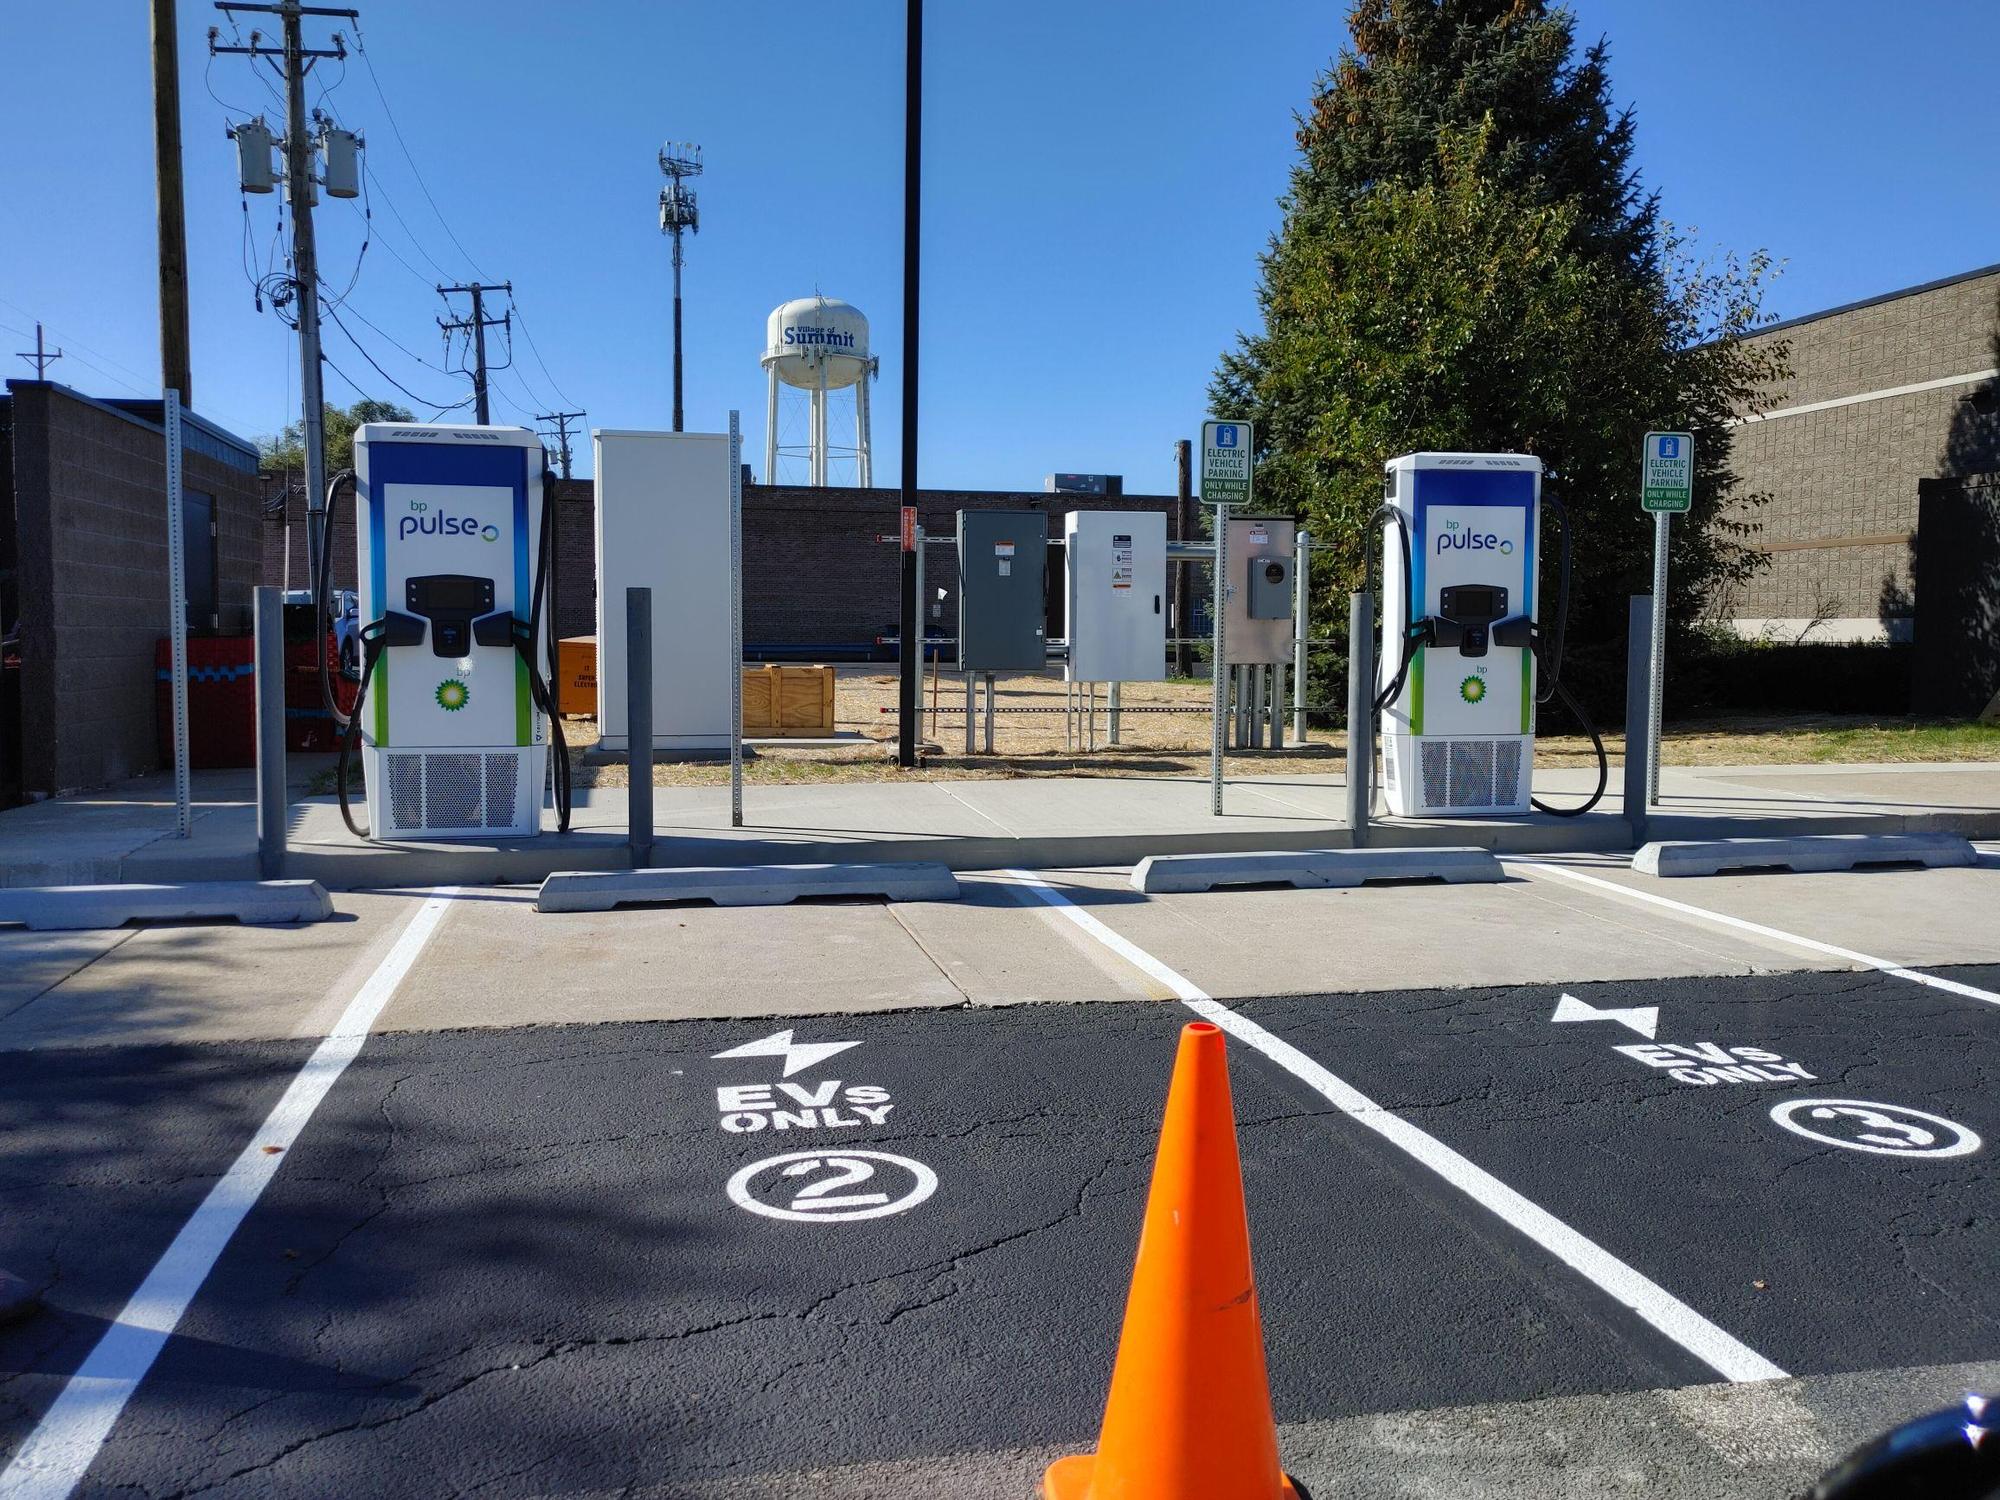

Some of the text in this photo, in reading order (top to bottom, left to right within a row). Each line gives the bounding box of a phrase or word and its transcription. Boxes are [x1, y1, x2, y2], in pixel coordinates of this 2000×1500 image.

[784, 326, 854, 347] Summit
[1207, 449, 1246, 458] ELECTRIC
[1209, 459, 1243, 468] VEHICLE
[1650, 459, 1686, 468] ELECTRIC
[1208, 469, 1244, 478] PARKING
[1651, 469, 1684, 477] VEHICLE
[1204, 481, 1248, 491] ONLY WHILE
[1650, 479, 1684, 487] PARKING
[1206, 491, 1244, 500] CHARGING
[1647, 490, 1687, 498] ONLY WHILE
[410, 499, 427, 513] bp
[1649, 500, 1684, 508] CHARGING
[399, 509, 478, 540] pulse
[1446, 519, 1459, 531] bp
[1437, 527, 1498, 555] pulse
[1476, 665, 1488, 674] bp
[1668, 1062, 1819, 1085] ONLY
[720, 1104, 895, 1133] ONLY
[1811, 1107, 1935, 1147] 3
[782, 1158, 889, 1210] 2
